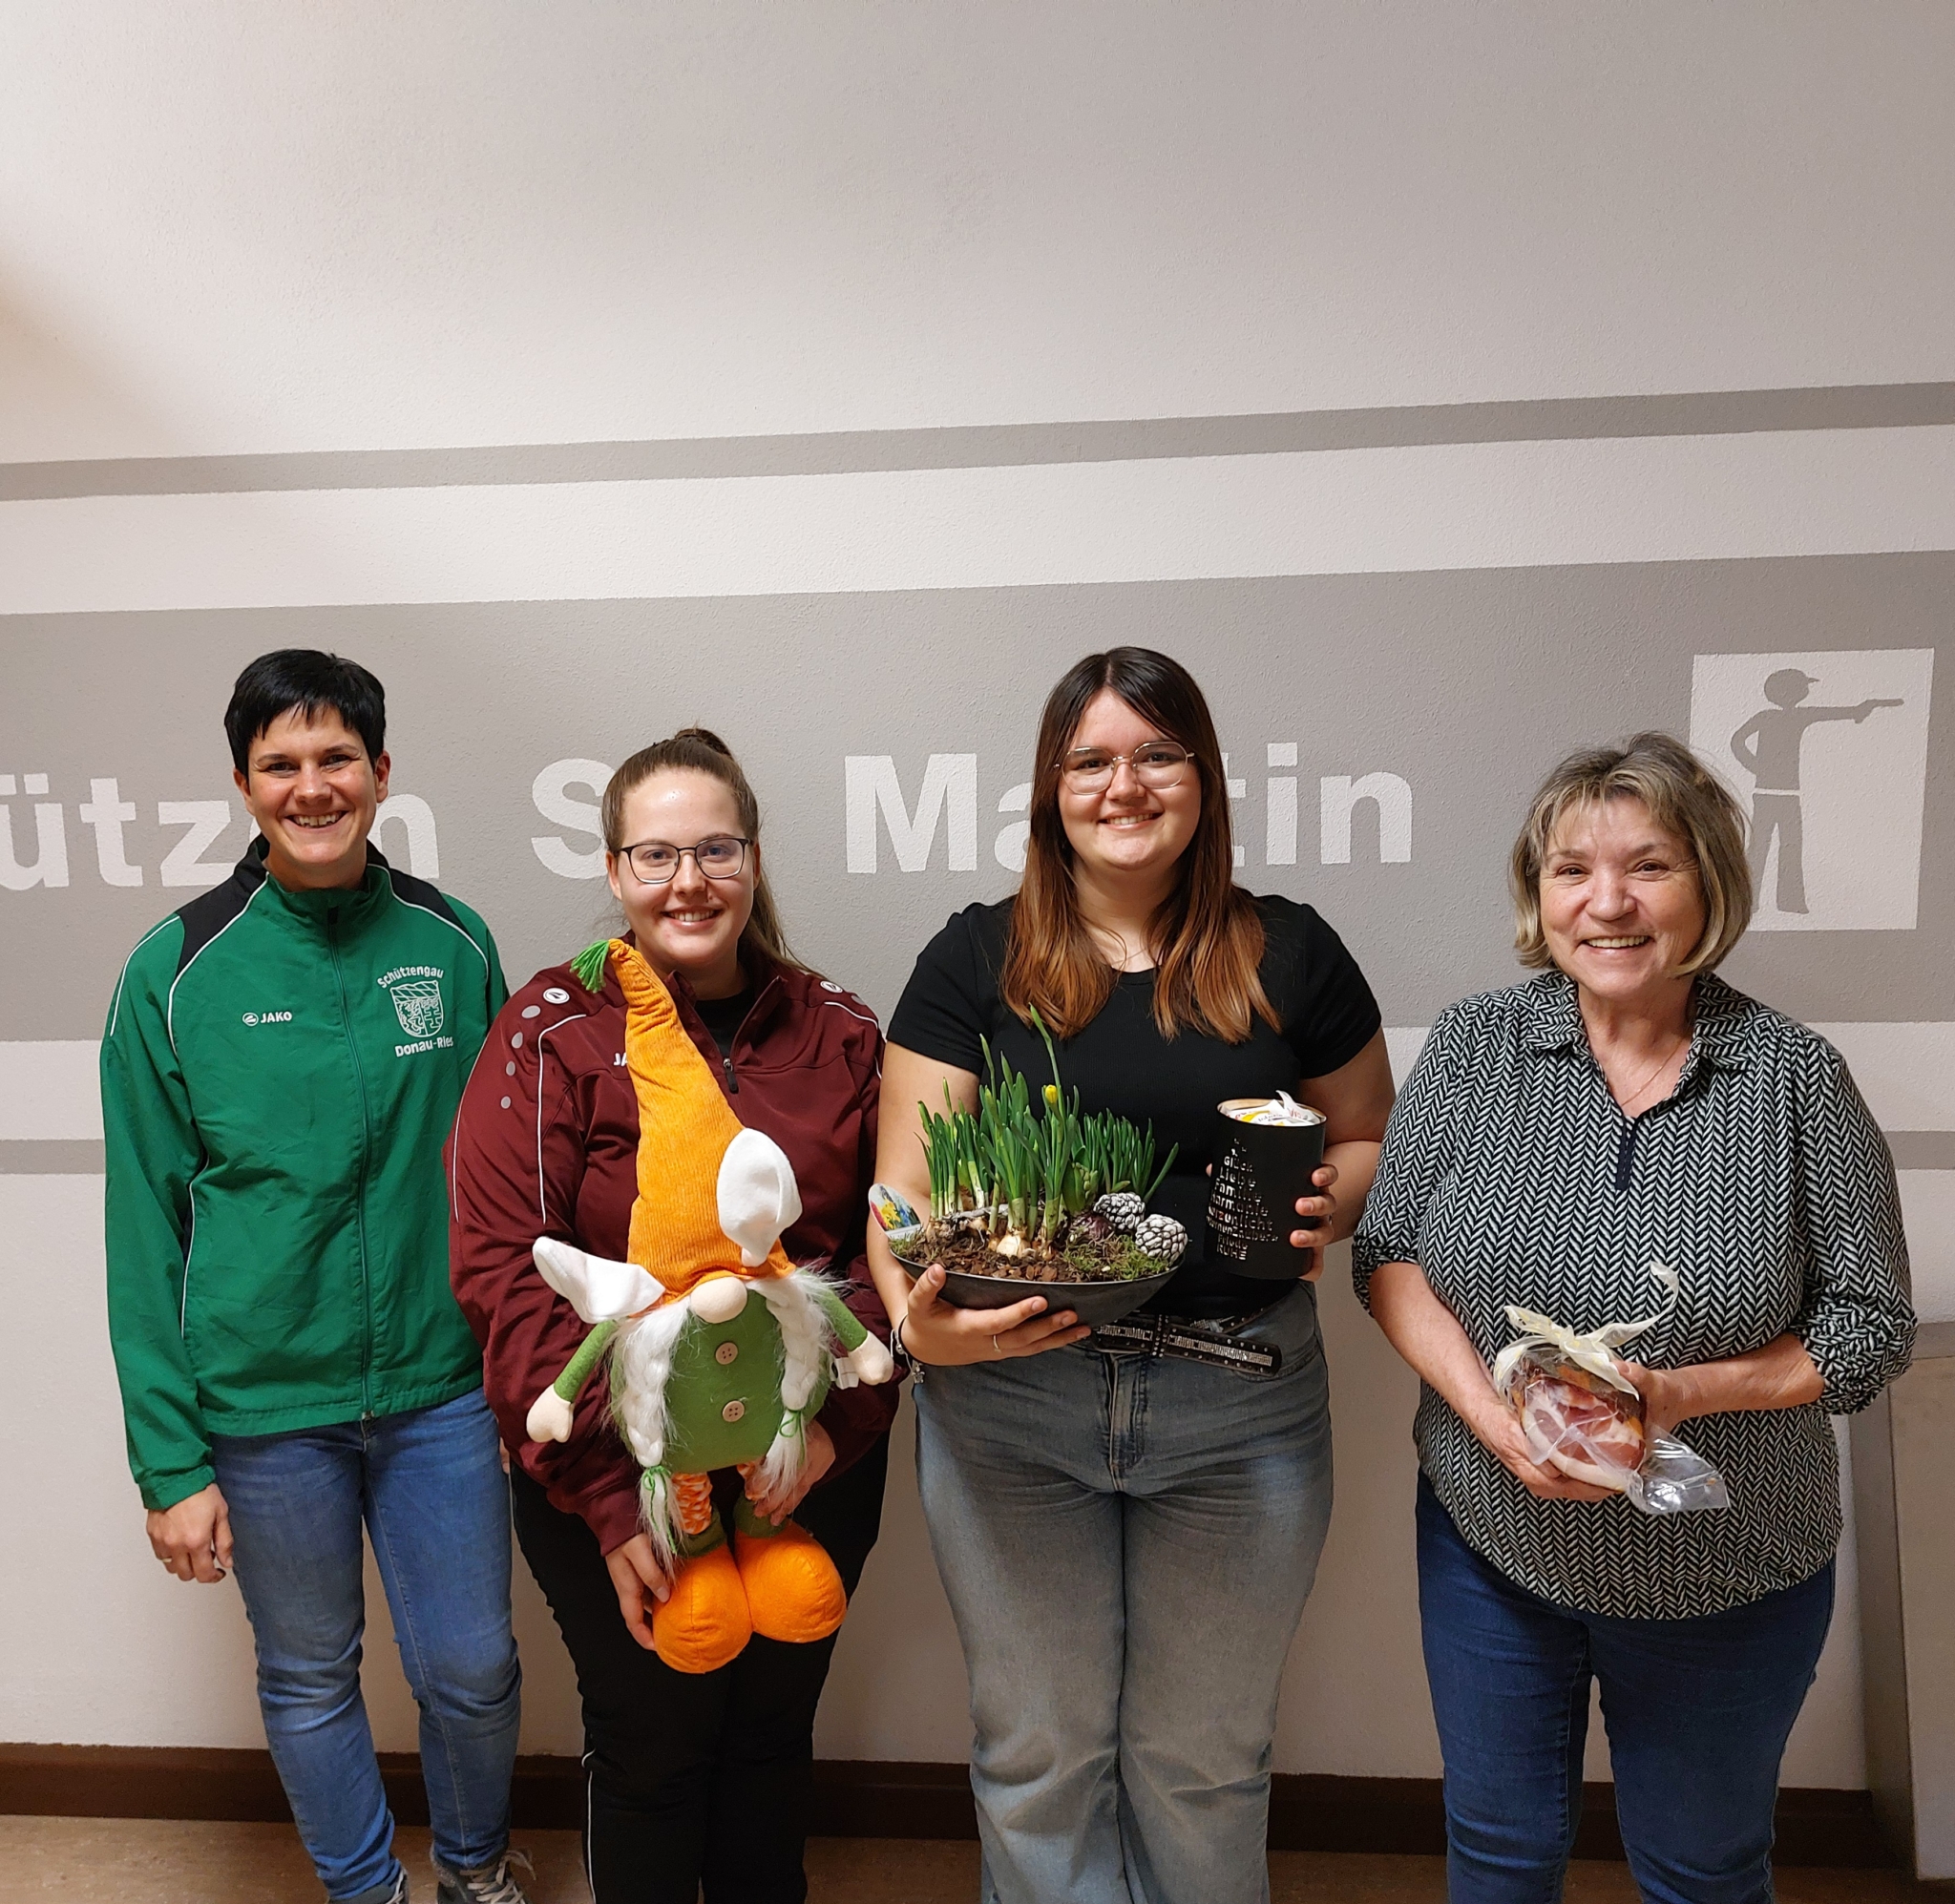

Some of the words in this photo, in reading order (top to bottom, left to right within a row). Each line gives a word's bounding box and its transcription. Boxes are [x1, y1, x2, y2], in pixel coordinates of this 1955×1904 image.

[0, 773, 439, 890] ützn
[531, 758, 617, 879] S
[845, 743, 1413, 873] Min
[377, 966, 444, 989] Schützengau
[261, 1011, 292, 1023] JAKO
[394, 1036, 453, 1057] Donau-Ries
[613, 1052, 628, 1067] JA
